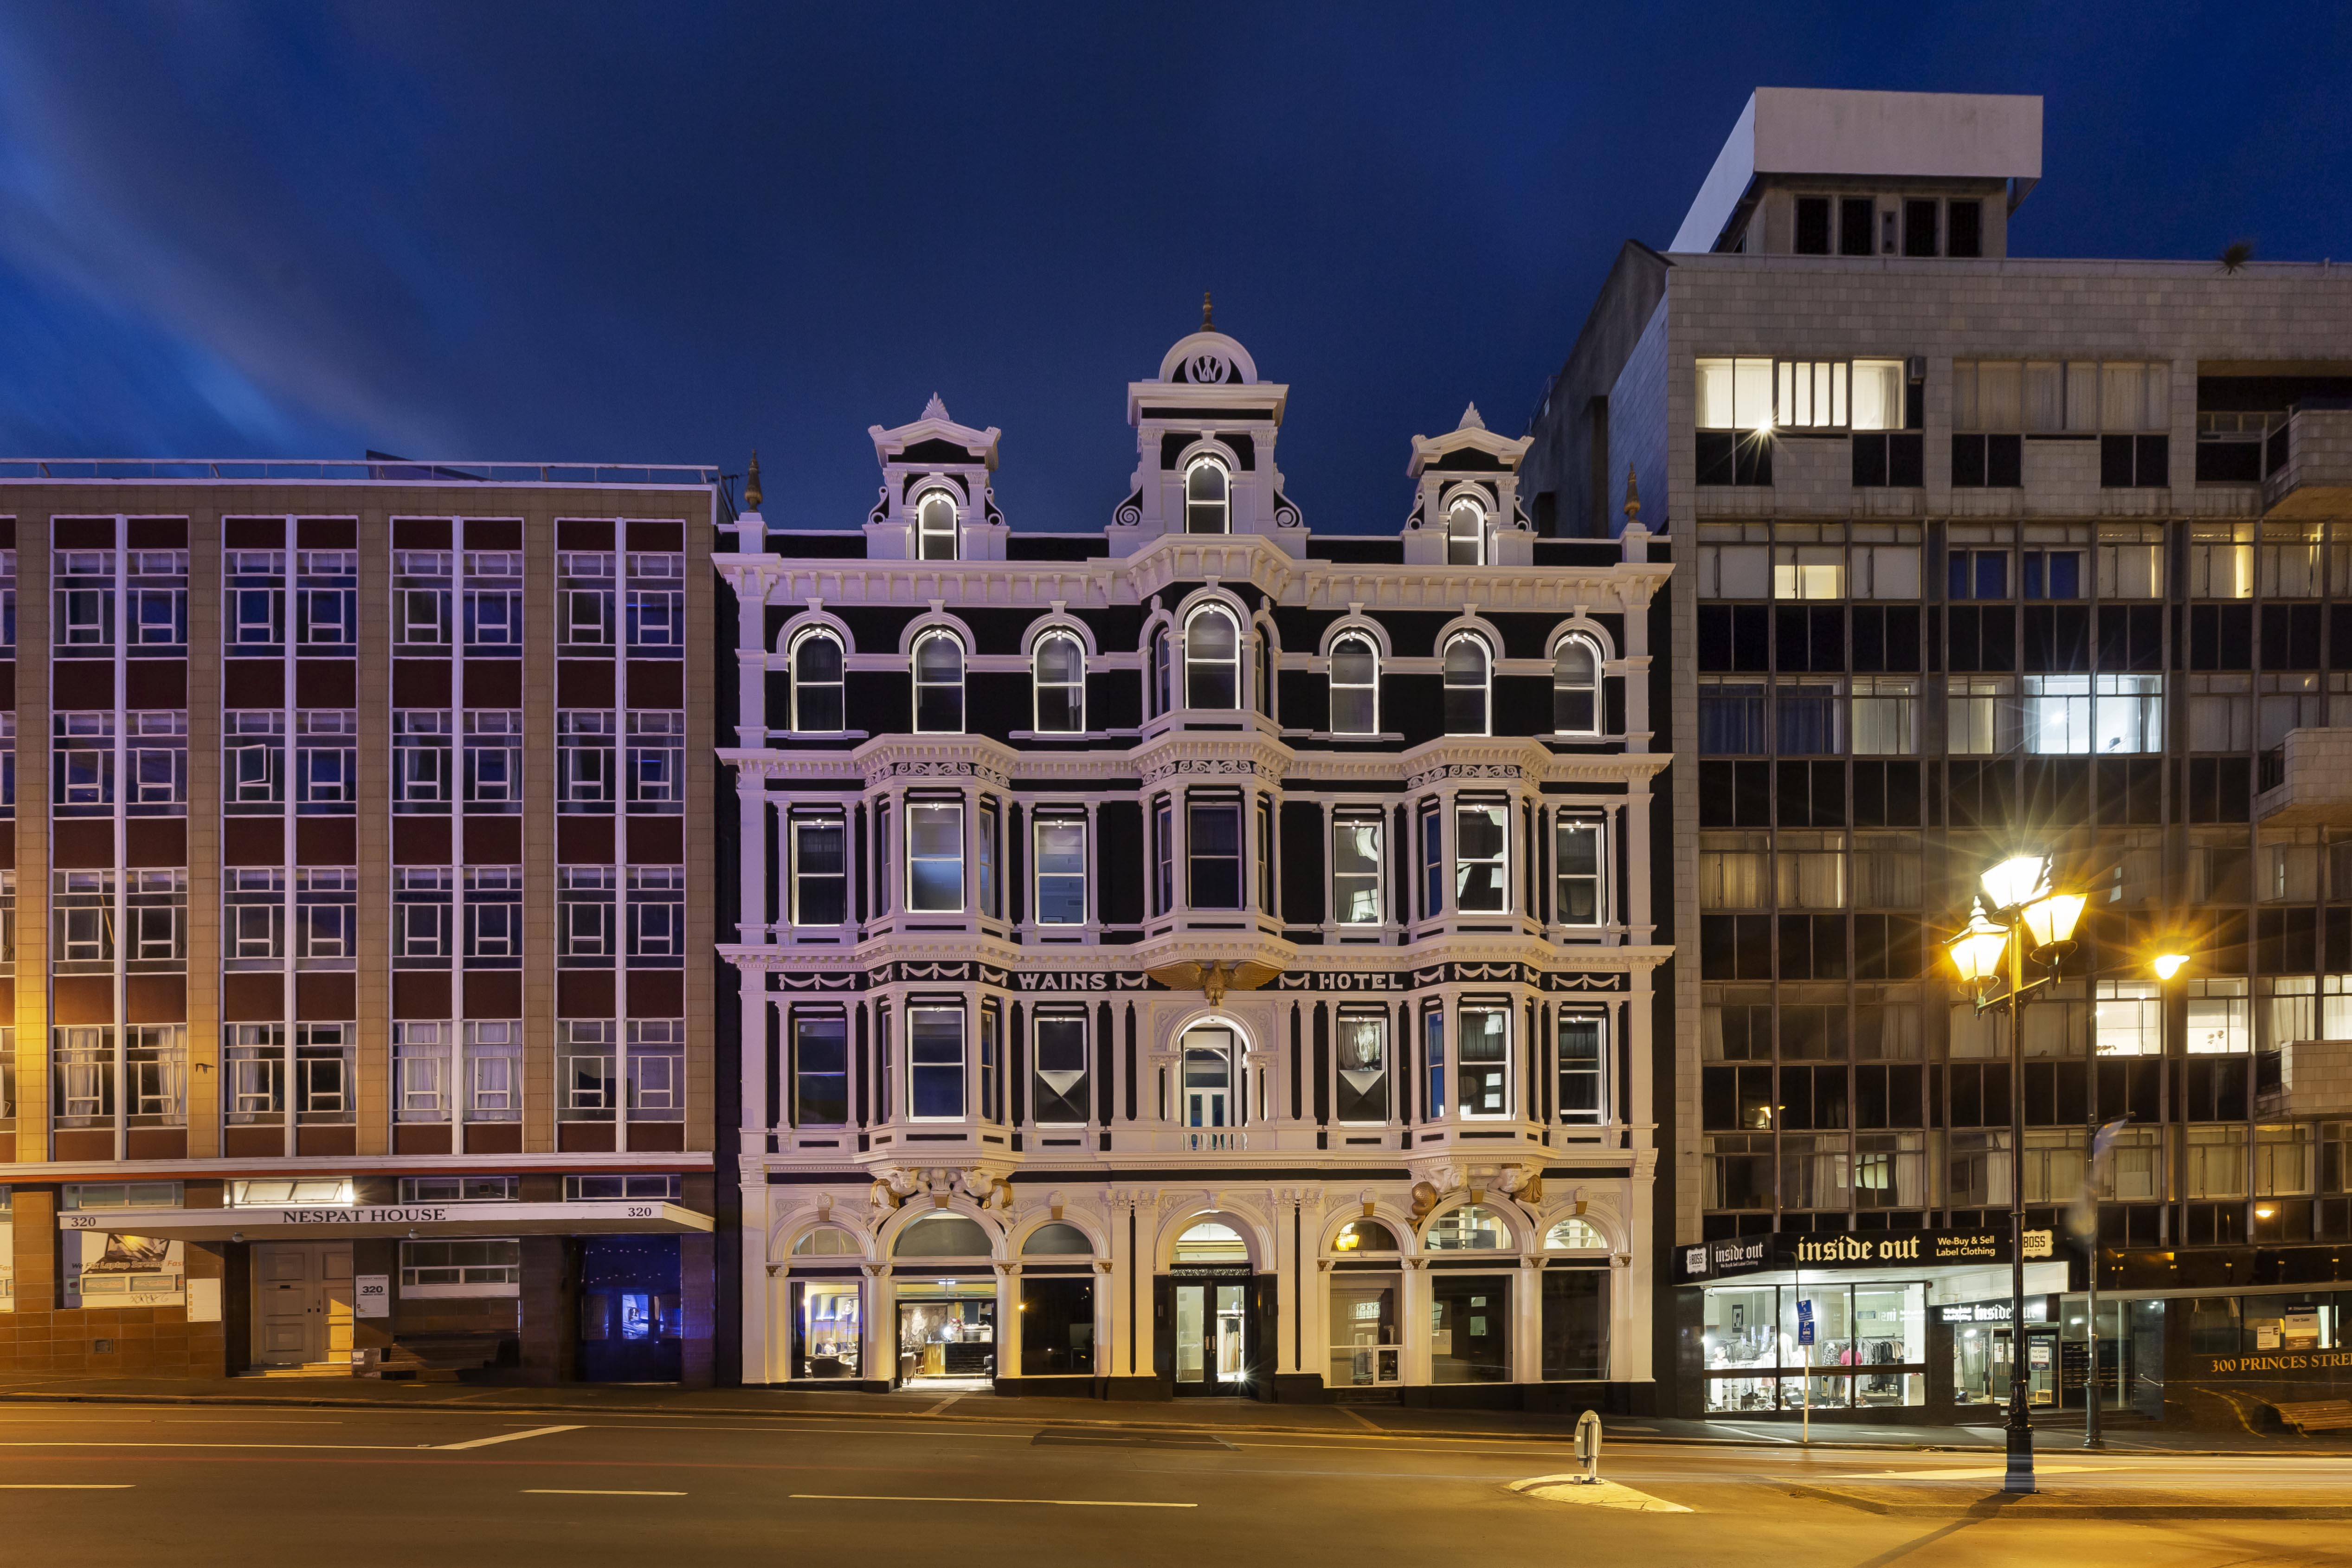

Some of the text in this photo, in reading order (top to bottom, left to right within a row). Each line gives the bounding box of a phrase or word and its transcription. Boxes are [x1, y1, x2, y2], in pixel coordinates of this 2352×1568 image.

[1018, 974, 1403, 990] WAINS HOTEL
[283, 1209, 446, 1223] NESPAT HOUSE
[628, 1207, 652, 1217] 320
[71, 1217, 96, 1227] 320
[1954, 1237, 1969, 1247] Buy
[1980, 1235, 1994, 1244] Sell
[2023, 1236, 2045, 1248] BOSS
[1716, 1242, 1763, 1263] inside out
[1798, 1235, 1920, 1262] inside out
[1936, 1247, 1995, 1257] Label Clothing
[1691, 1253, 1703, 1265] BOSS
[1974, 1304, 2012, 1320] inside
[2273, 1327, 2278, 1336] E
[2210, 1359, 2236, 1372] 300
[2240, 1355, 2307, 1371] PRINCES
